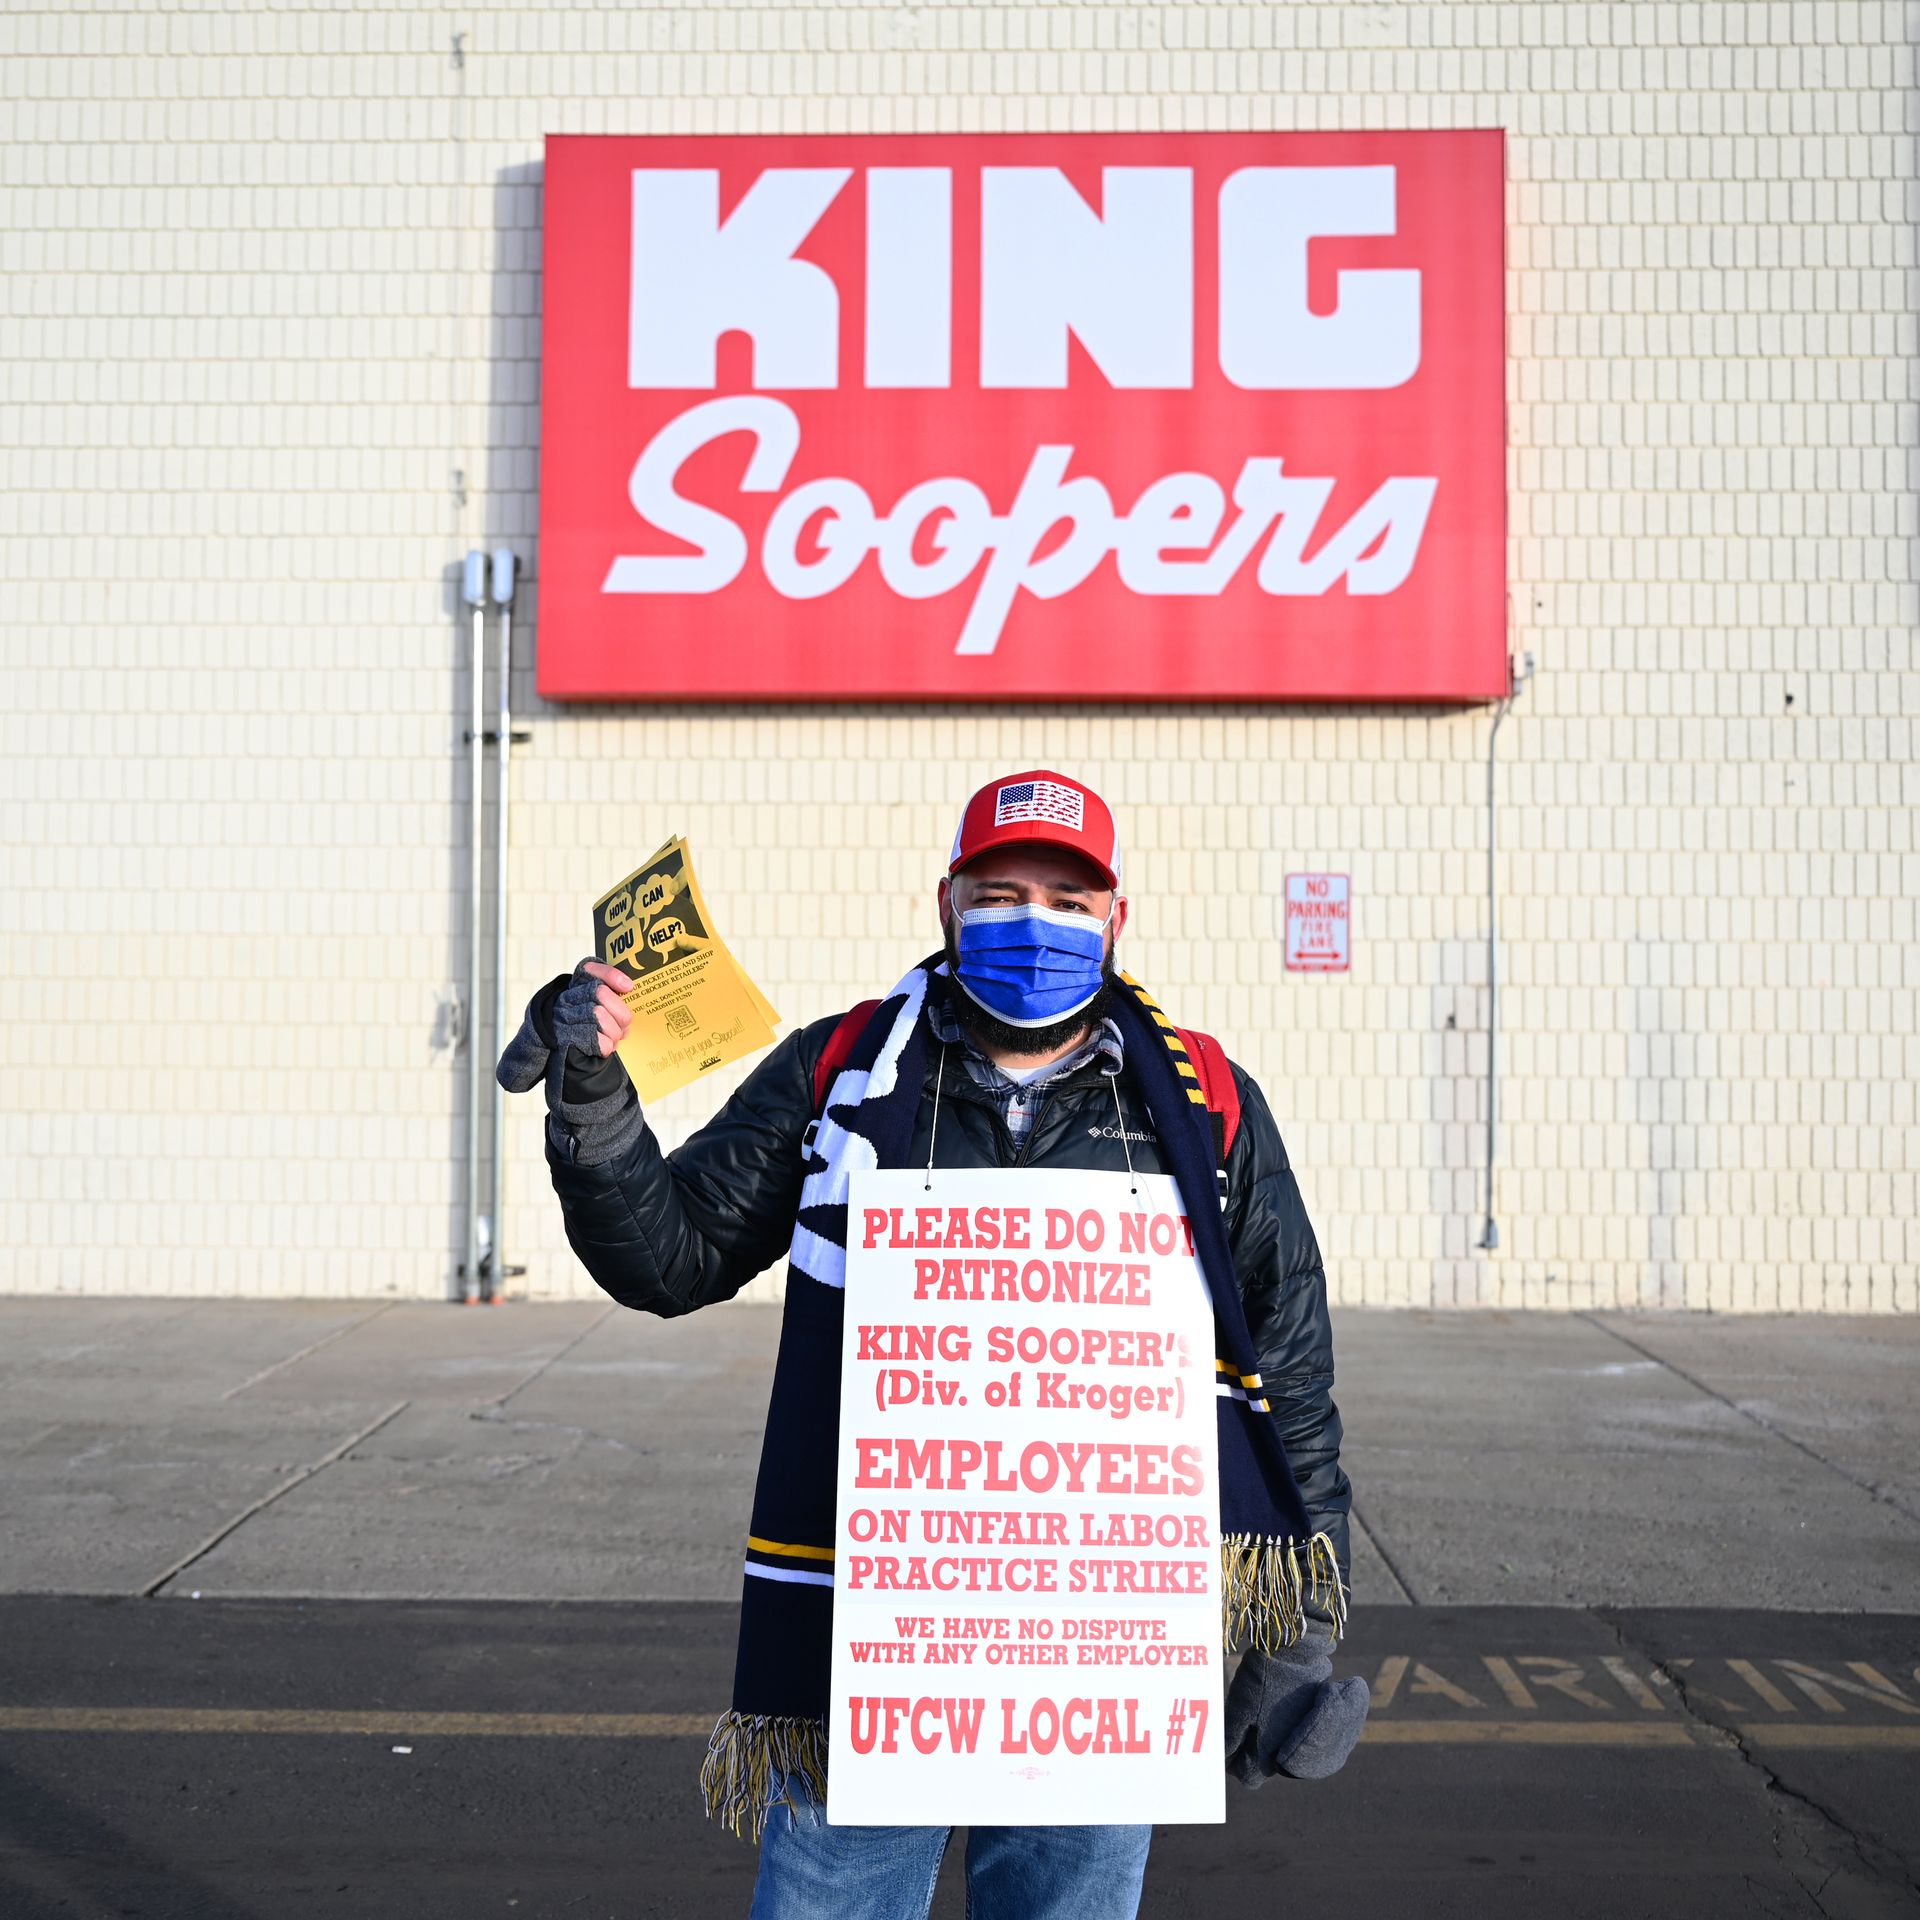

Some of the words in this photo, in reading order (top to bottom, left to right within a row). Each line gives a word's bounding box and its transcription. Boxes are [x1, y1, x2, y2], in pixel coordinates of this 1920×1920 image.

[628, 165, 1421, 389] KING
[601, 394, 1438, 655] Soopers
[609, 898, 627, 921] HOW
[642, 884, 664, 908] CAN
[1306, 880, 1329, 897] NO
[1288, 901, 1345, 918] PARKING
[610, 928, 634, 958] YOU
[649, 921, 682, 947] HELP?
[632, 983, 641, 991] UR
[642, 972, 665, 987] PICKET
[665, 965, 682, 976] LINE
[682, 958, 696, 968] AND
[696, 950, 714, 962] SHOP
[623, 992, 641, 1004] THER
[641, 979, 670, 996] GROCERY
[632, 1004, 645, 1014] YOU
[660, 988, 684, 1001] DONATE
[683, 983, 692, 991] TO
[692, 977, 706, 987] OUR
[646, 999, 675, 1015] HARDSHIP
[676, 991, 693, 1001] FUND
[1102, 1126, 1157, 1143] Columbia
[863, 1207, 1030, 1249] PLEASE
[1045, 1208, 1105, 1252] DO
[1119, 1212, 1195, 1257] NOT
[914, 1259, 1151, 1306] PATRONIZE
[857, 1325, 972, 1362] KING
[876, 1369, 968, 1412] (Div.
[984, 1371, 1021, 1407] of
[1037, 1372, 1185, 1419] Kroger)
[855, 1438, 1204, 1496] EMPLOYEES
[848, 1508, 911, 1543] ON
[921, 1510, 1070, 1545] UNFAIR
[1080, 1513, 1210, 1547] LABOR
[848, 1556, 1057, 1592] PRACTICE
[1069, 1559, 1207, 1594] STRIKE
[895, 1617, 935, 1638] WE
[943, 1618, 1010, 1639] HAVE
[1018, 1619, 1054, 1640] NO
[1062, 1619, 1166, 1640] DISPUTE
[850, 1642, 916, 1663] WITH
[923, 1643, 978, 1664] ANY
[985, 1643, 1068, 1665] OTHER
[1077, 1644, 1208, 1666] EMPLOYER
[1368, 1656, 1920, 1714] ARKIN
[849, 1696, 985, 1755] UFCW
[1000, 1697, 1150, 1755] LOCAL
[1166, 1698, 1208, 1755] #7
